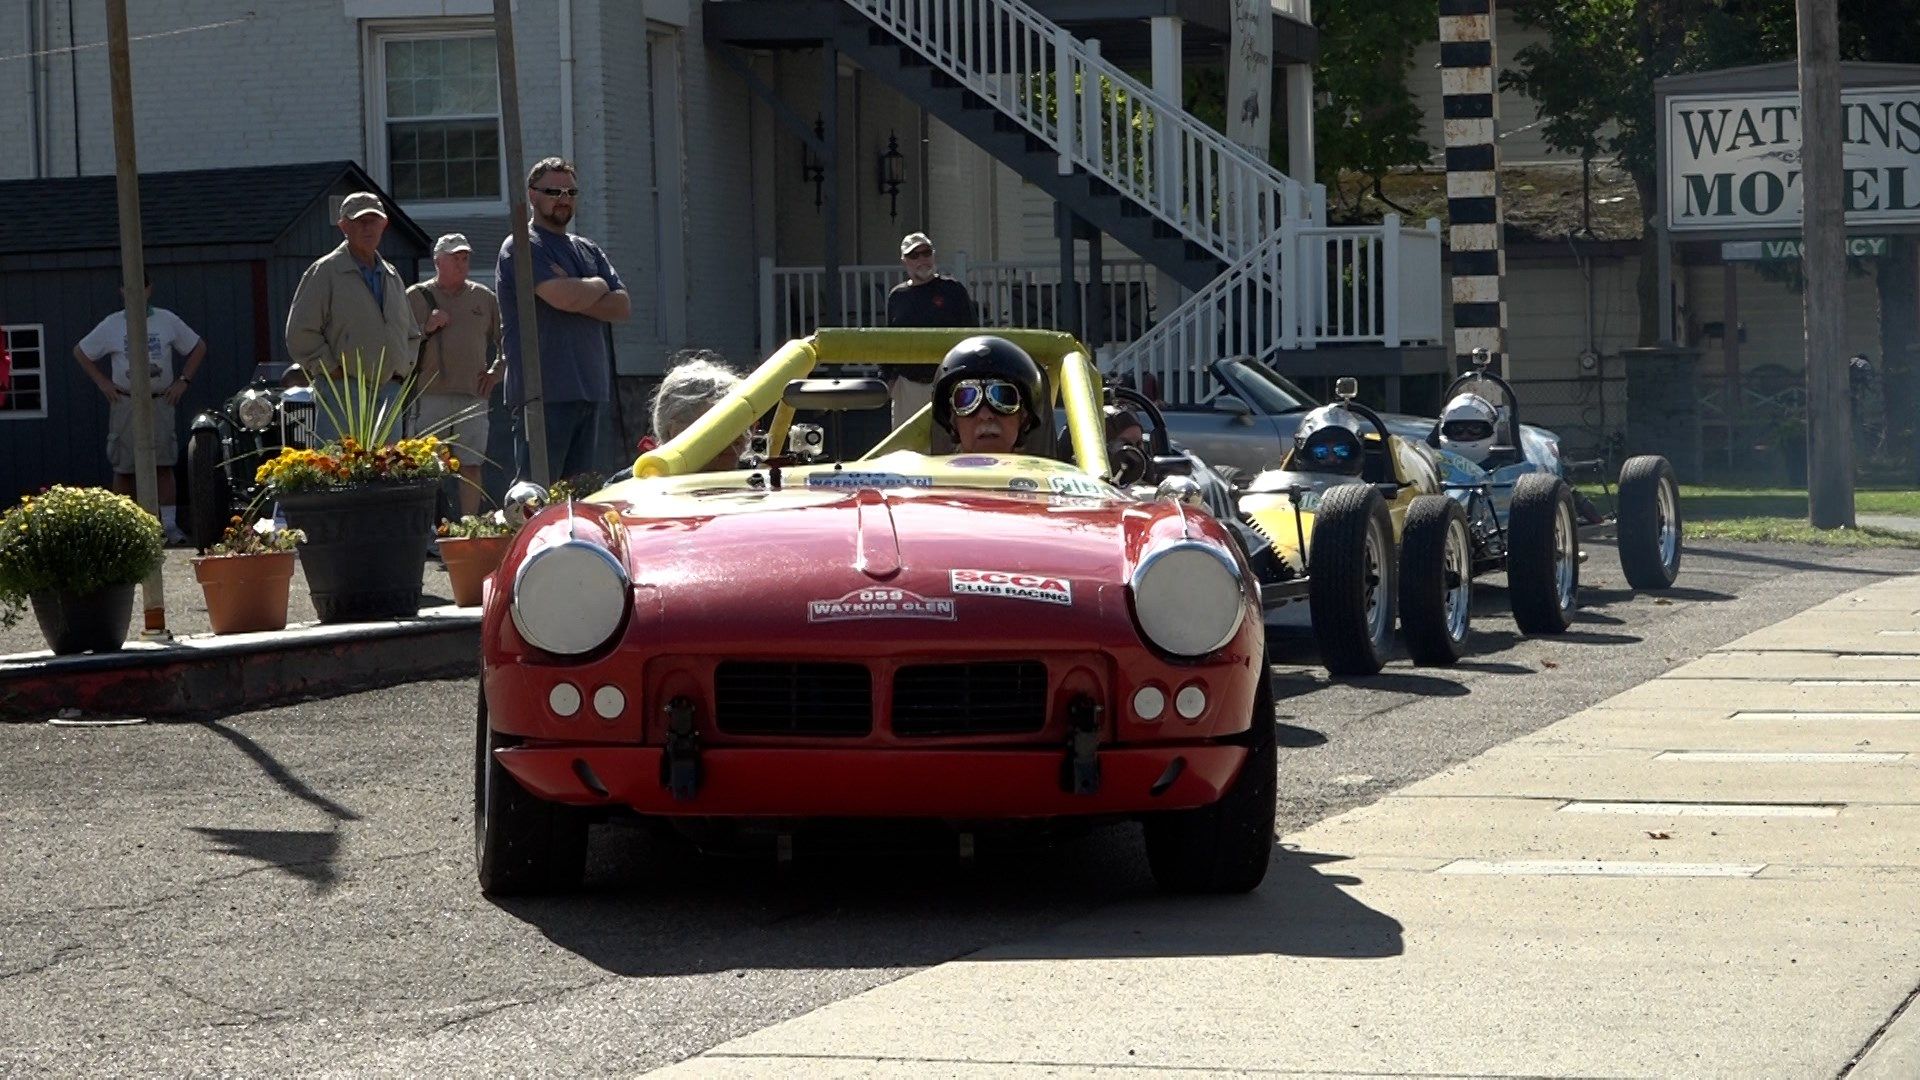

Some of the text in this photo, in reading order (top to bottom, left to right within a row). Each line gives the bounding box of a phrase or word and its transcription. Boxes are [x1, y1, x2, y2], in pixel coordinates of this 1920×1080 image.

[1678, 101, 1920, 160] WATINS
[1681, 167, 1920, 217] MOEL
[1766, 238, 1885, 258] VACY
[954, 571, 1067, 592] SCCA
[954, 583, 1069, 602] CLUB RACING
[813, 601, 951, 614] WATKINS GLEN
